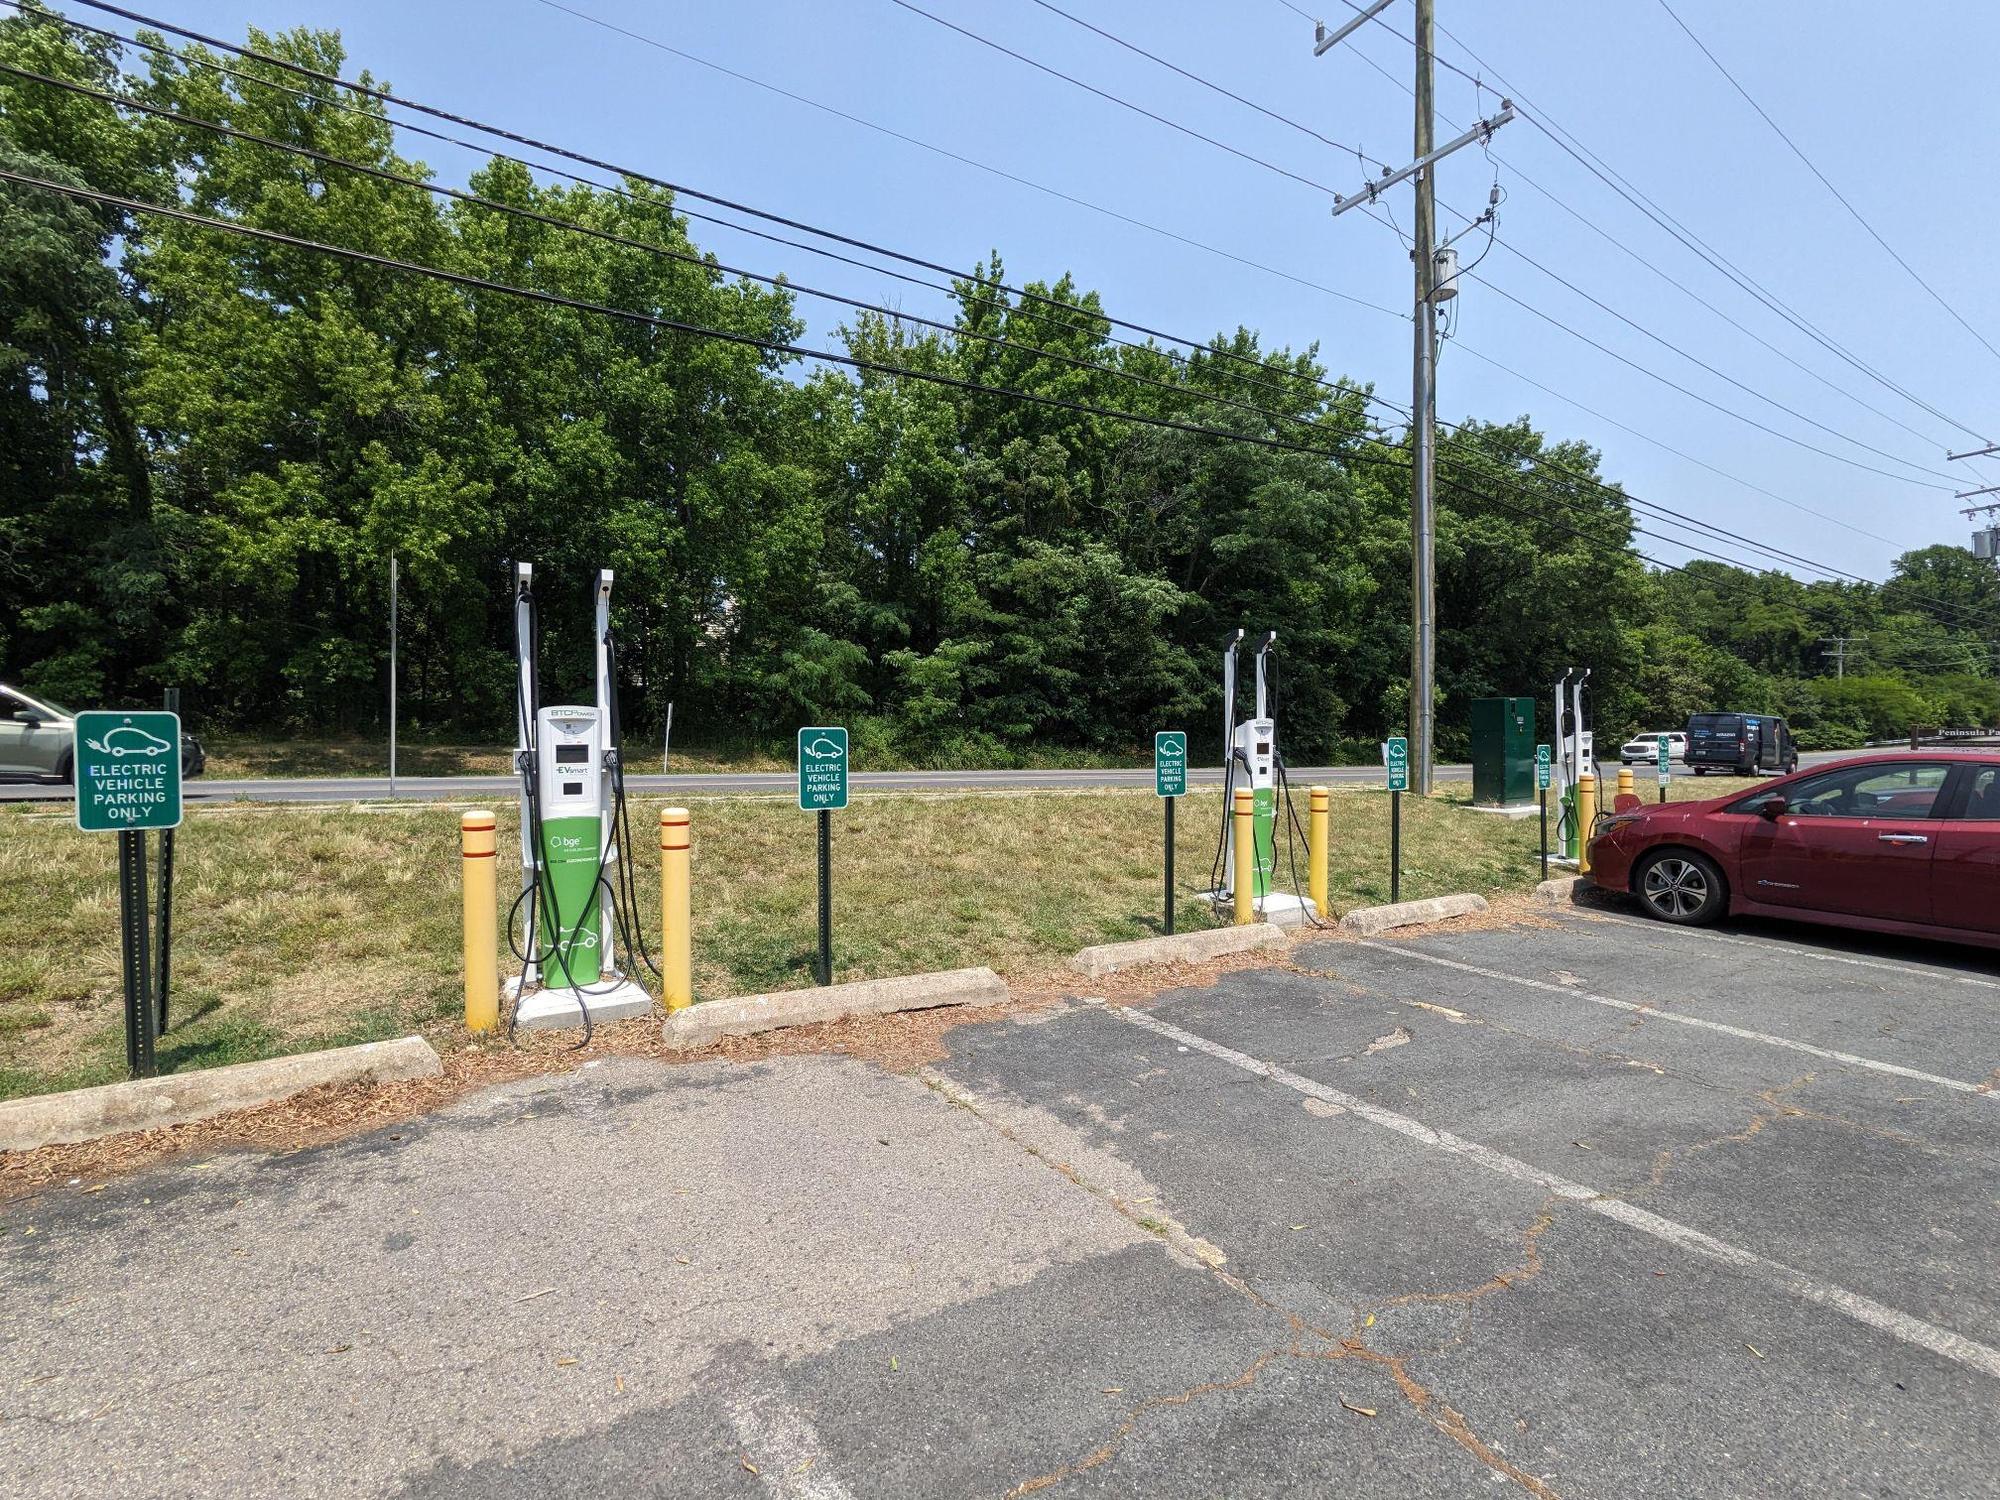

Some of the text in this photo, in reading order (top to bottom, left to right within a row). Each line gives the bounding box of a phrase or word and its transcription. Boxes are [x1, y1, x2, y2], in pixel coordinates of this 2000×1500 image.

[805, 764, 842, 773] ELECTRIC
[1159, 760, 1182, 768] ELECTRIC
[89, 764, 167, 777] ELECTRIC
[1161, 767, 1181, 775] VEHICLE
[807, 774, 840, 783] VEHICLE
[1160, 775, 1182, 783] PARKING
[95, 778, 165, 791] VEHICLE
[806, 784, 841, 792] PARKING
[94, 792, 166, 805] PARKING
[813, 793, 835, 802] ONLY
[108, 806, 153, 819] ONLY
[563, 836, 580, 848] bge
